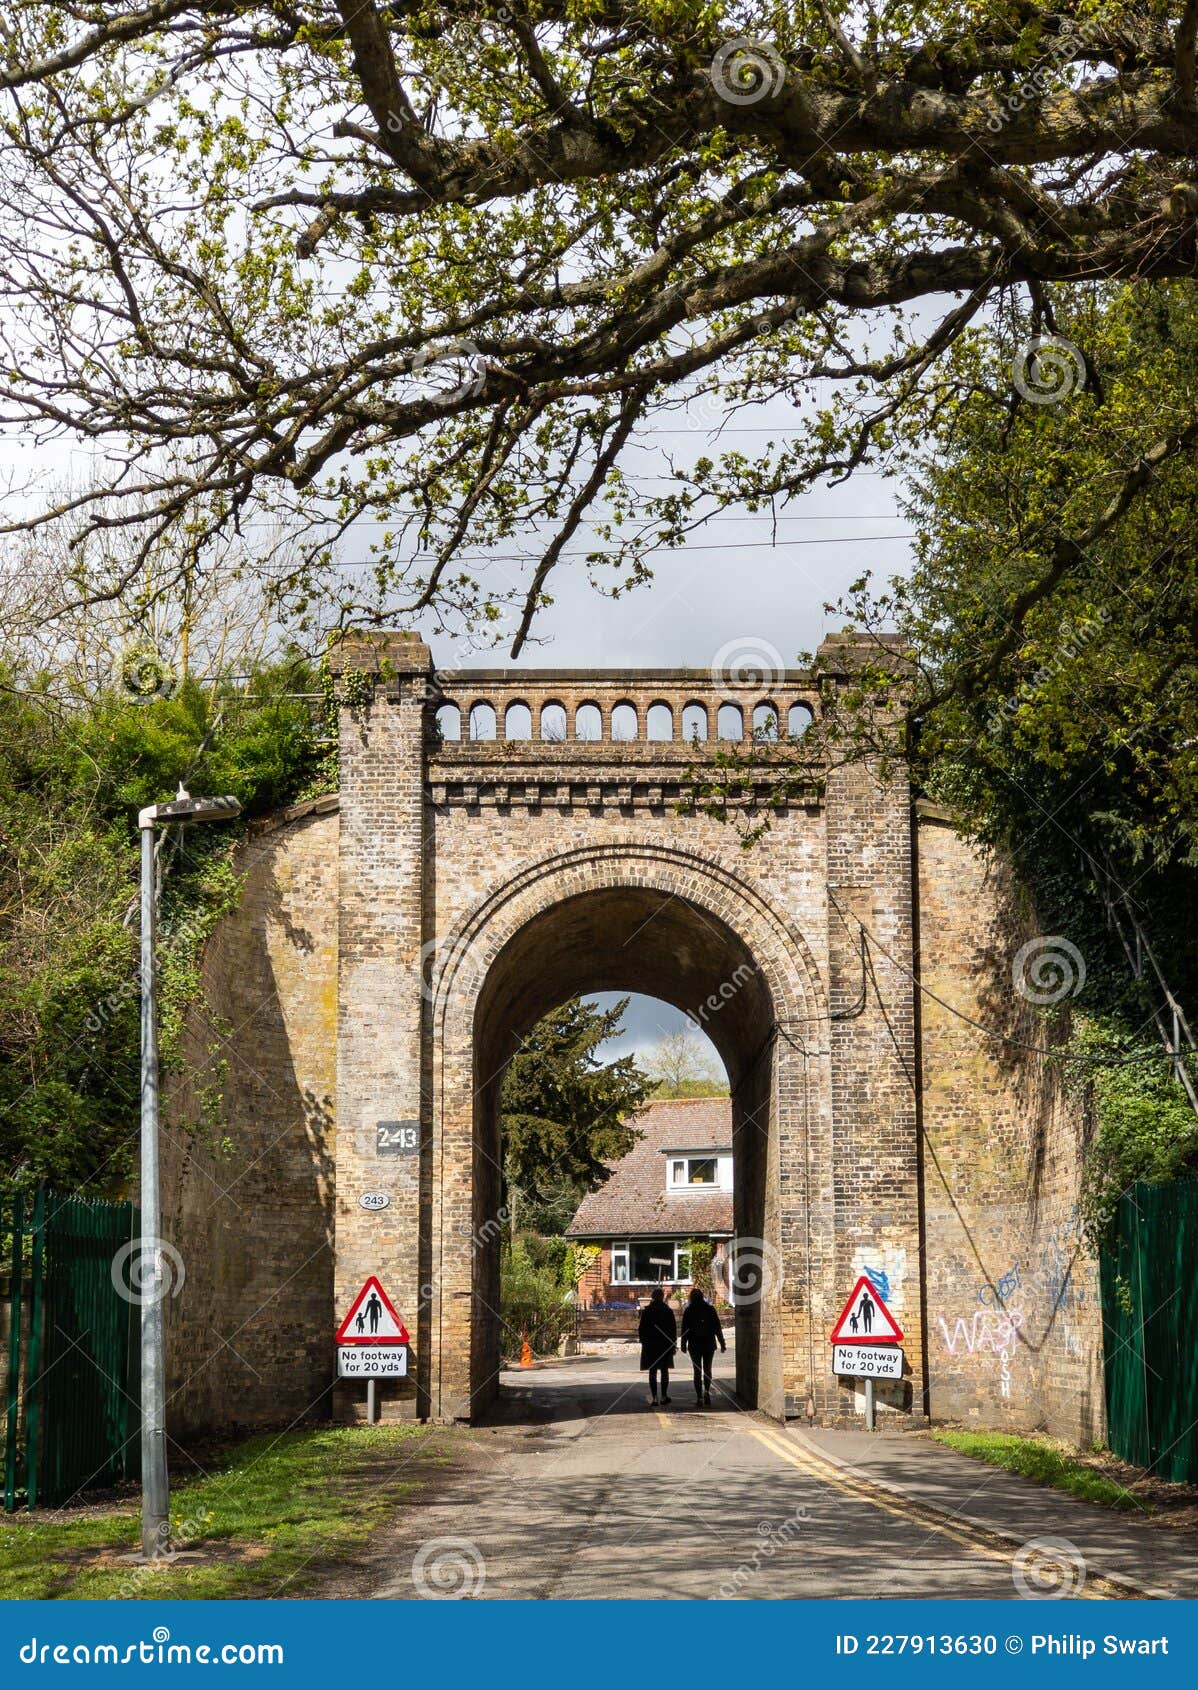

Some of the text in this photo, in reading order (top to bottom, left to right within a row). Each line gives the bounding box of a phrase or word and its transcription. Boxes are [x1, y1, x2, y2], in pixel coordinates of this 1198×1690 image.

[378, 1127, 417, 1148] 243
[364, 1196, 384, 1205] 243
[342, 1351, 403, 1362] No footway
[838, 1349, 898, 1364] No footway
[345, 1362, 399, 1373] for 20 yds
[841, 1361, 895, 1374] for 20 yds
